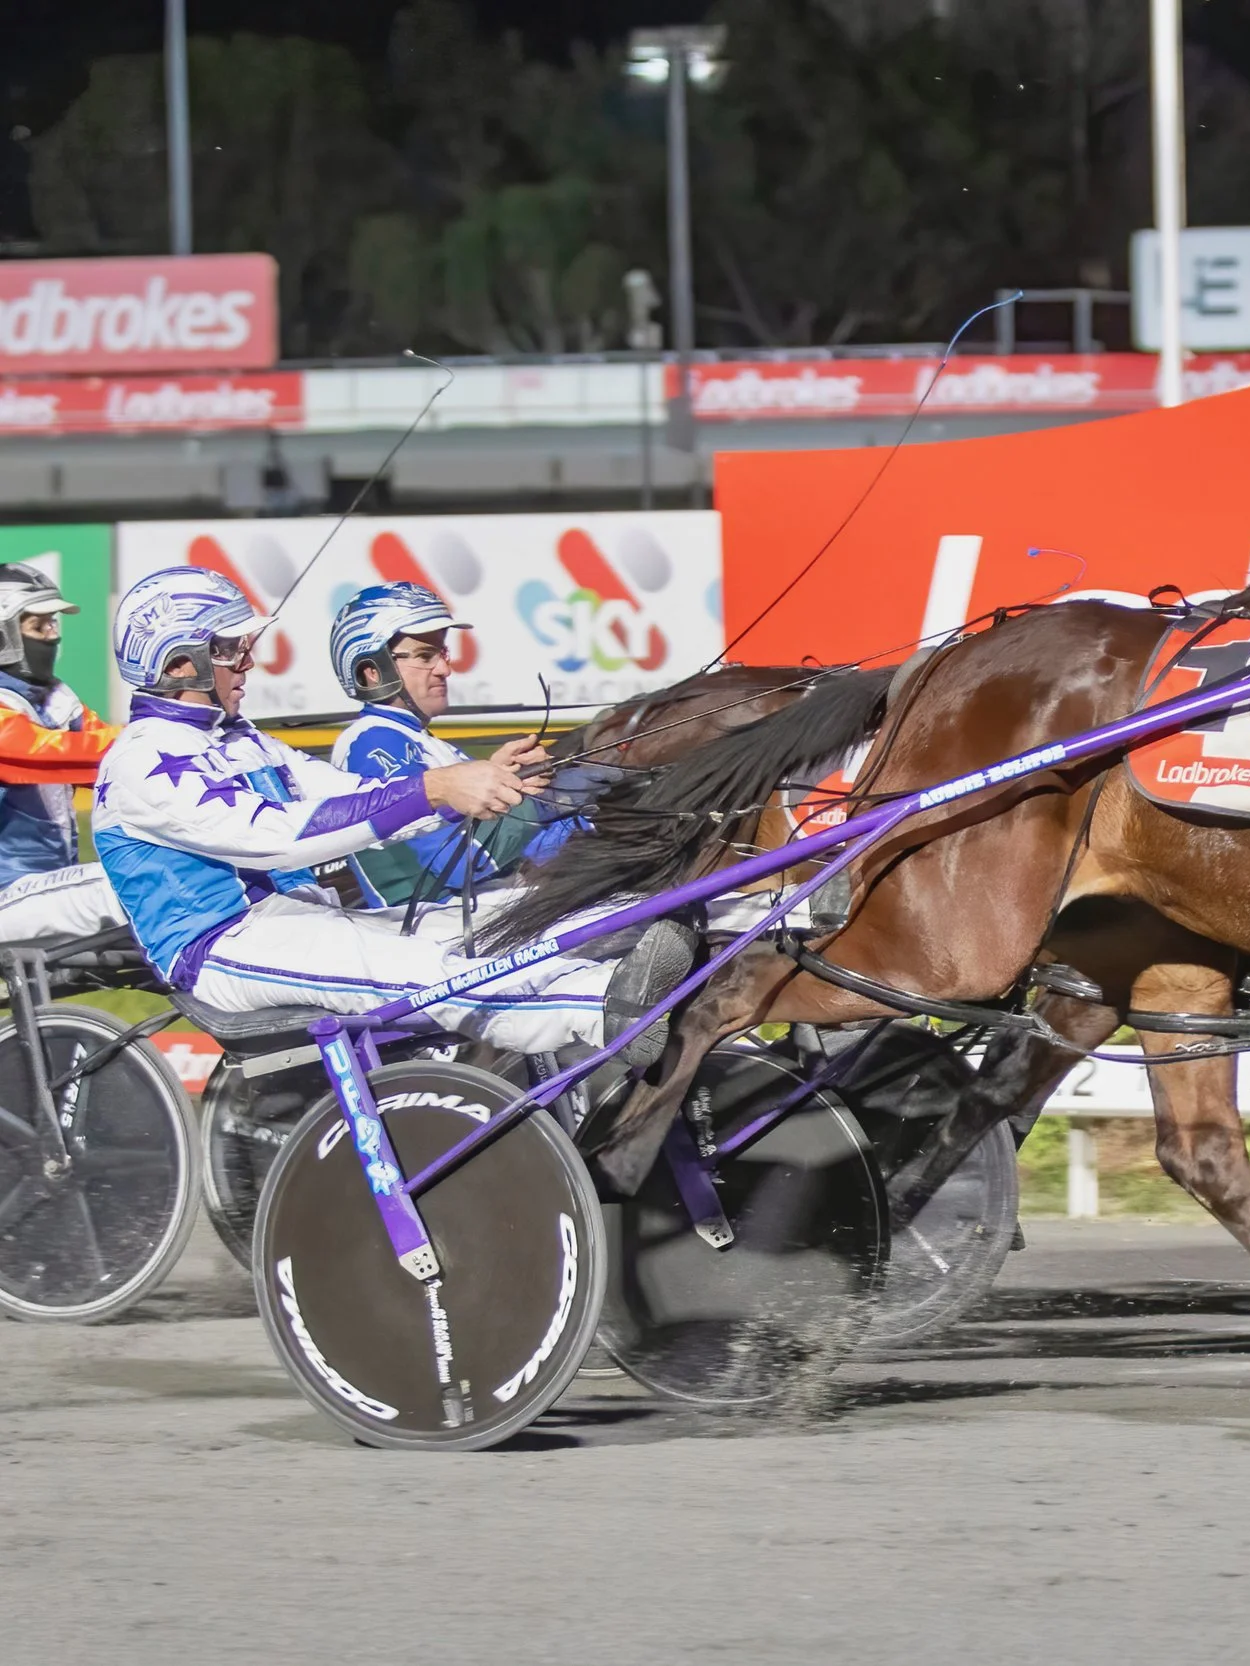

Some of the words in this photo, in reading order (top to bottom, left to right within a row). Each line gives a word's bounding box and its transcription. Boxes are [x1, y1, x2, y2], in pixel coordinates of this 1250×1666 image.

[0, 275, 255, 354] dbrokes
[551, 681, 676, 703] RACI
[408, 981, 451, 1008] TURPIN
[452, 957, 514, 991] McMULLEN
[514, 938, 560, 966] RACING
[318, 1092, 491, 1160] CRIMA
[277, 1256, 400, 1421] CORIMA
[493, 1212, 578, 1402] CORIMA
